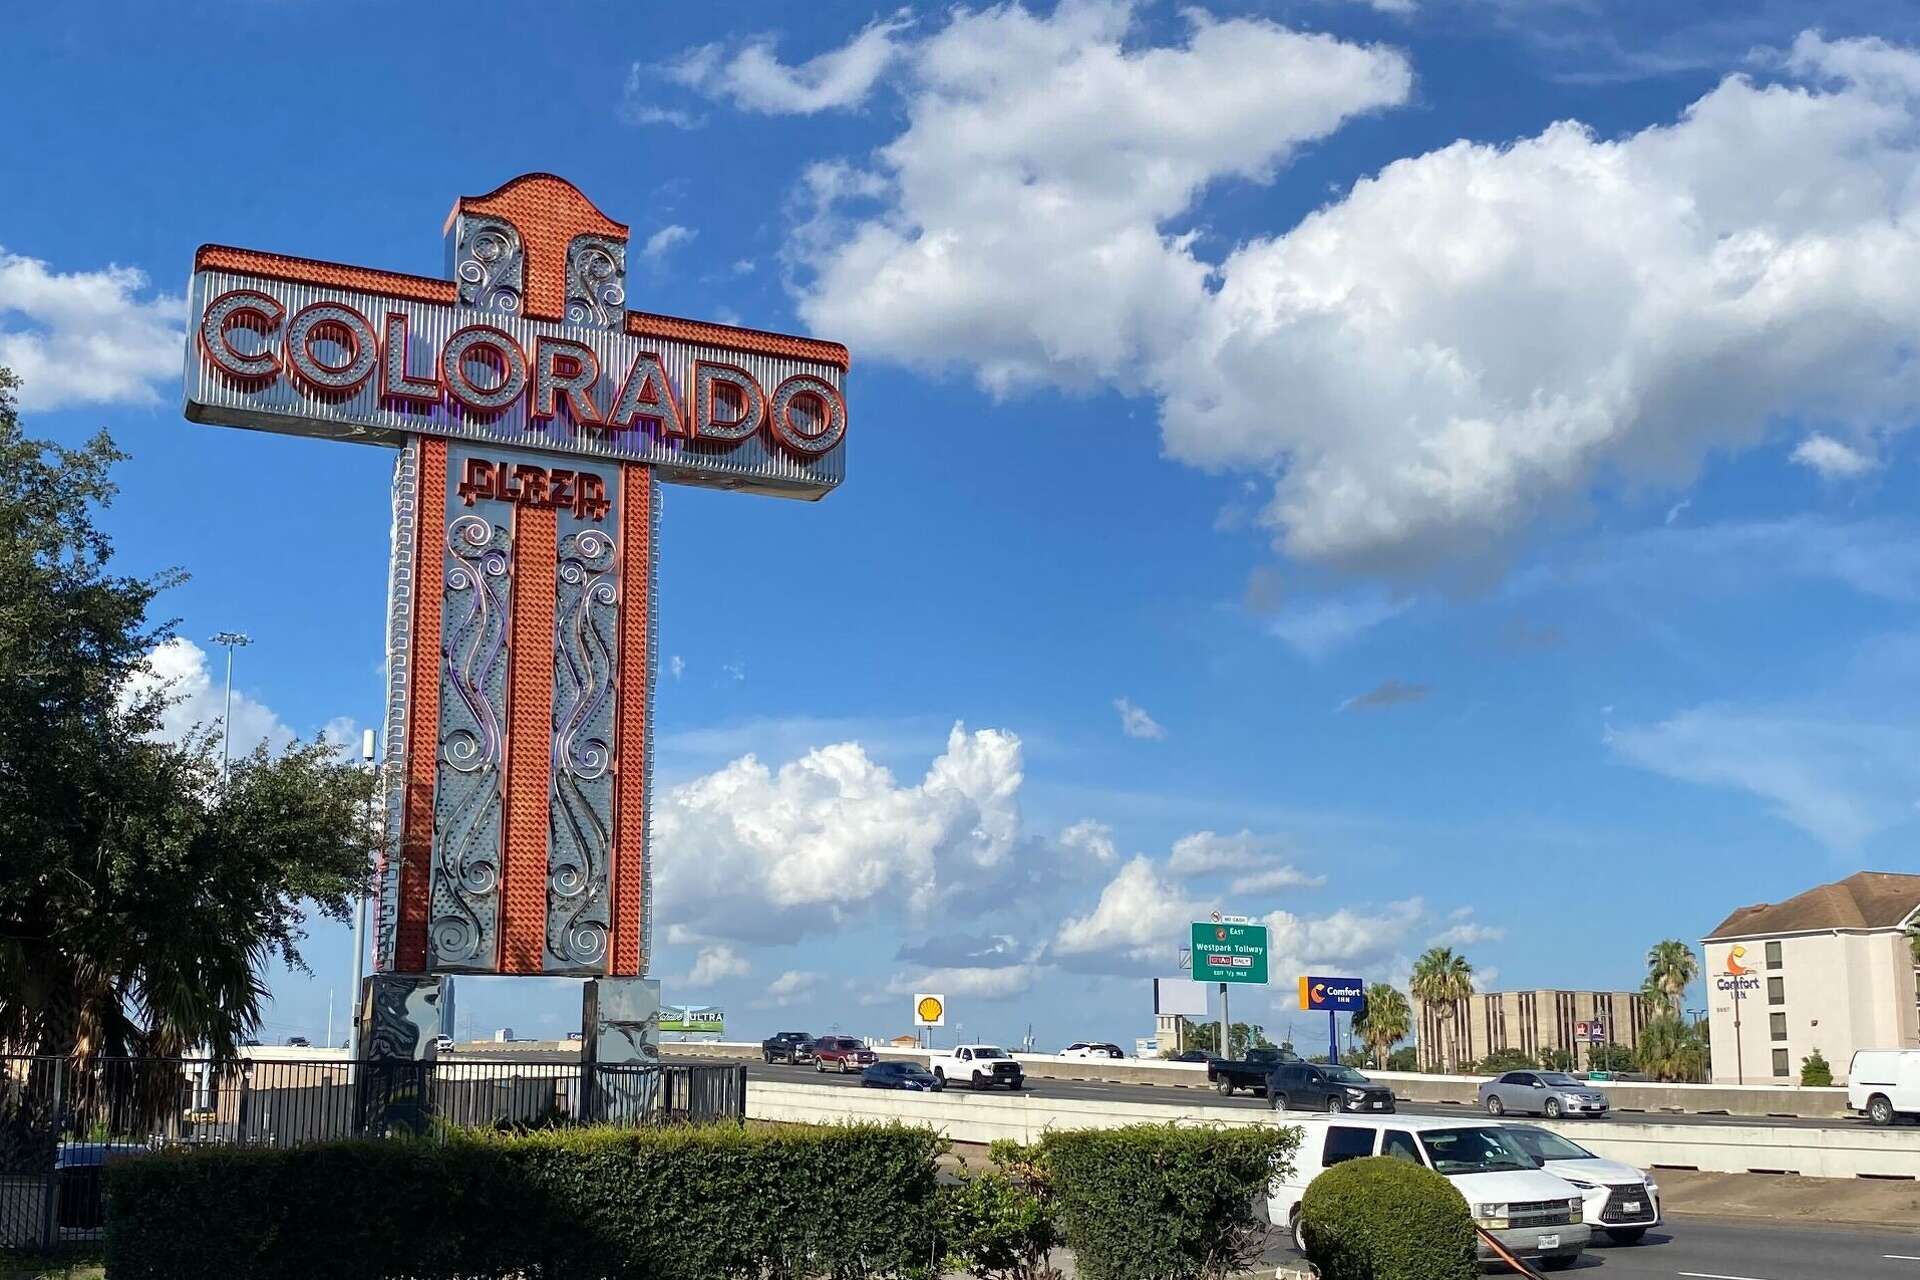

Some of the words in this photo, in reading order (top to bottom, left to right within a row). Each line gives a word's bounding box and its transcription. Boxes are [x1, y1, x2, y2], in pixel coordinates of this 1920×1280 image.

[198, 289, 848, 456] COLORADO
[457, 458, 611, 522] PLAZA
[1196, 943, 1232, 952] Westpark
[1234, 945, 1263, 955] Tollway
[1717, 977, 1760, 991] Comfort
[1327, 987, 1360, 996] Comfort
[689, 1013, 722, 1022] ULTRA
